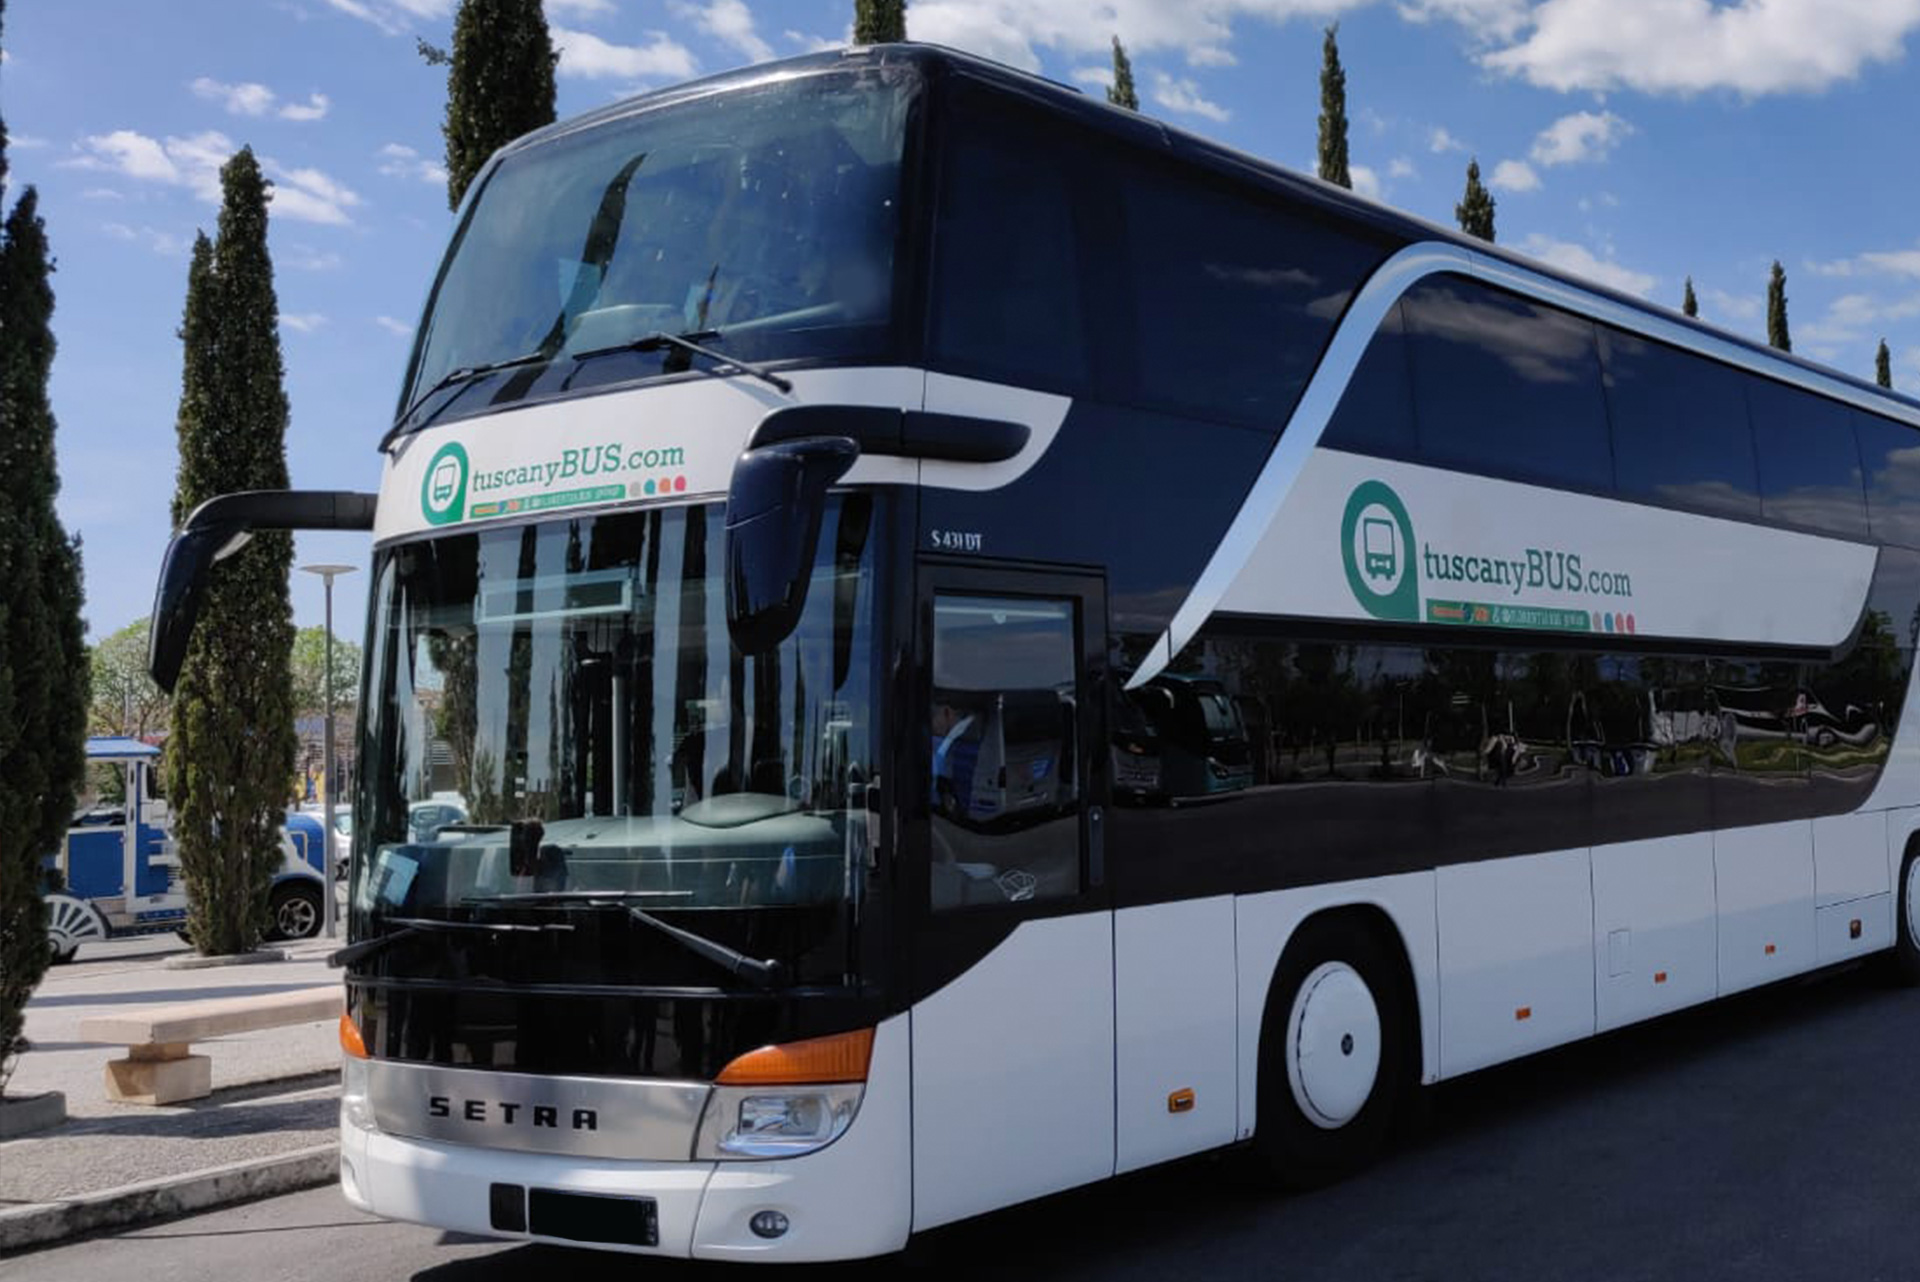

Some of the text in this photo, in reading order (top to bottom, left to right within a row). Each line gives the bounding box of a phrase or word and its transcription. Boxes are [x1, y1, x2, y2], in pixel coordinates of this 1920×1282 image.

[472, 443, 685, 493] tuscanyBUS.com
[931, 530, 941, 547] S
[965, 533, 982, 551] DT
[1424, 541, 1632, 597] tuscanyBUS.com
[429, 1096, 597, 1130] SETRA
